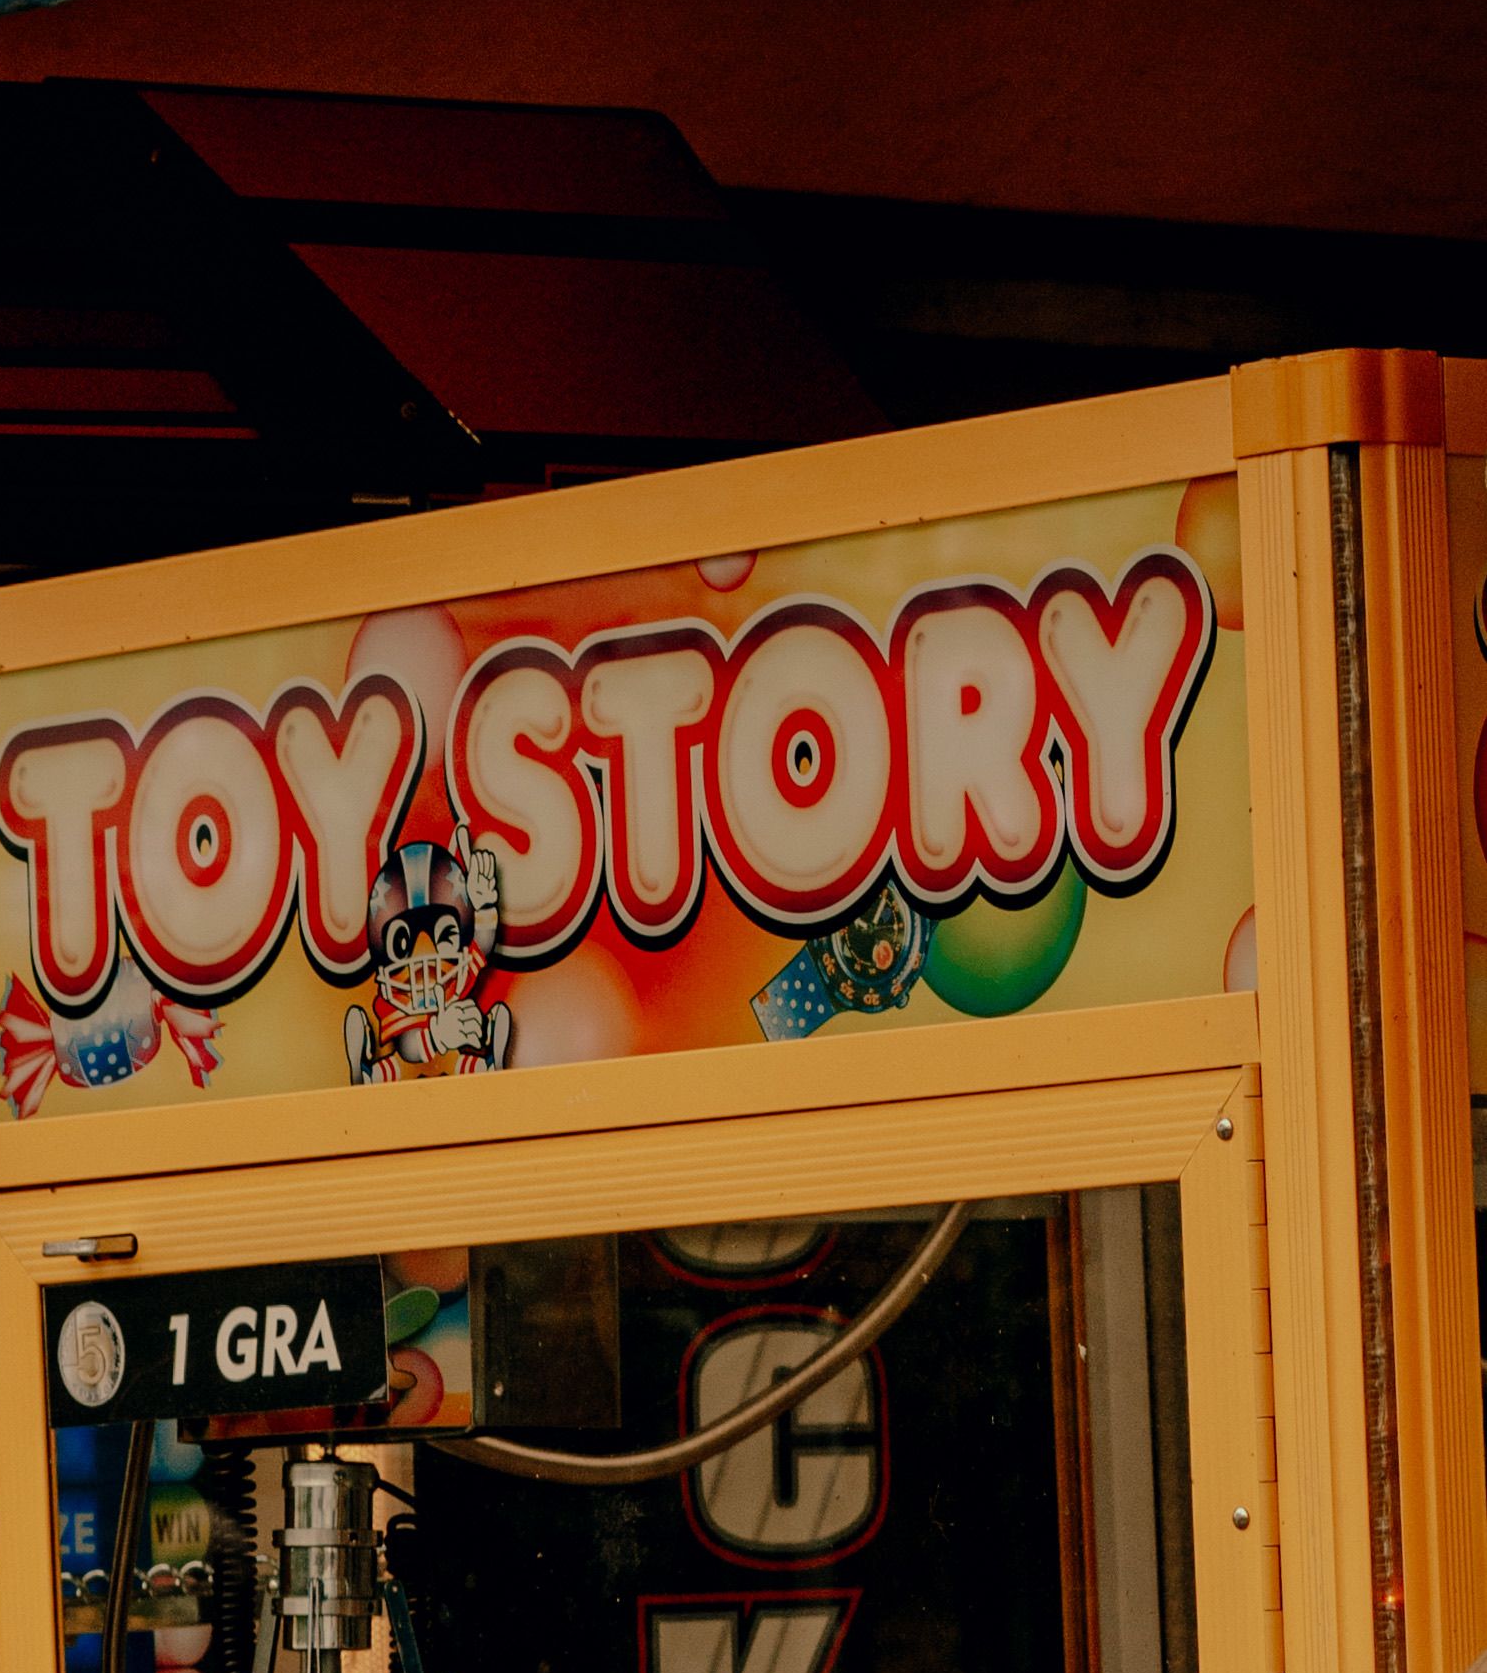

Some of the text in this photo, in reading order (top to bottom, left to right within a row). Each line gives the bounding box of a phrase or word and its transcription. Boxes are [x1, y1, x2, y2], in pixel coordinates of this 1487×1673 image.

[449, 551, 1209, 957] STORY
[169, 1300, 343, 1387] 1 GRA
[155, 1512, 201, 1544] WIN
